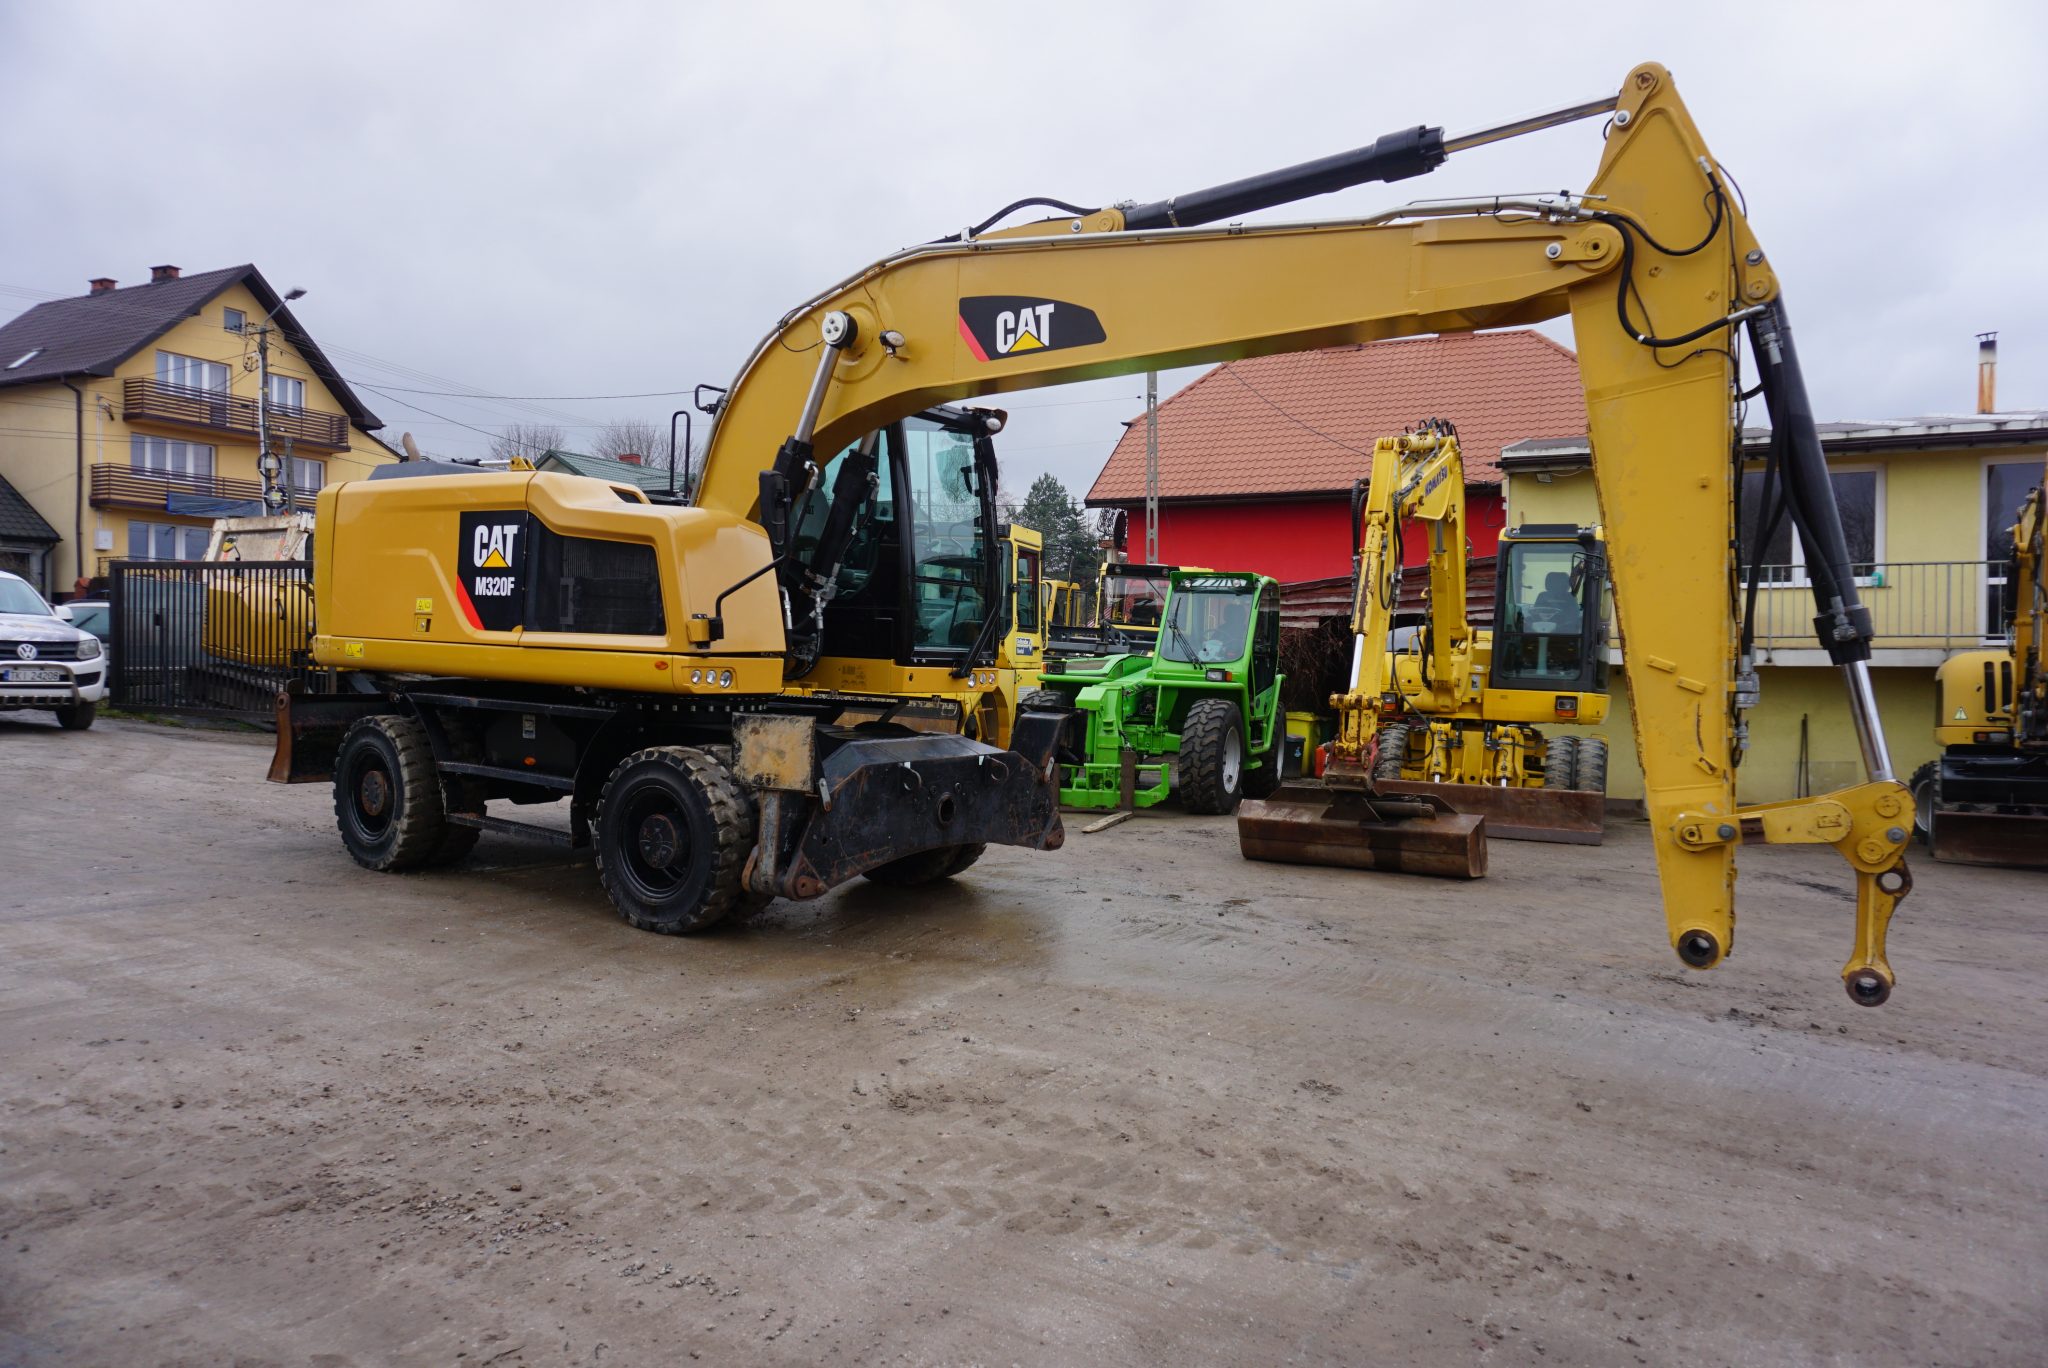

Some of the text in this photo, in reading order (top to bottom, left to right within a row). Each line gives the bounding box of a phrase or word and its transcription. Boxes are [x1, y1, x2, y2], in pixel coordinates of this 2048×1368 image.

[996, 303, 1055, 354] CAT
[473, 524, 518, 568] CAT
[475, 576, 516, 597] M320F
